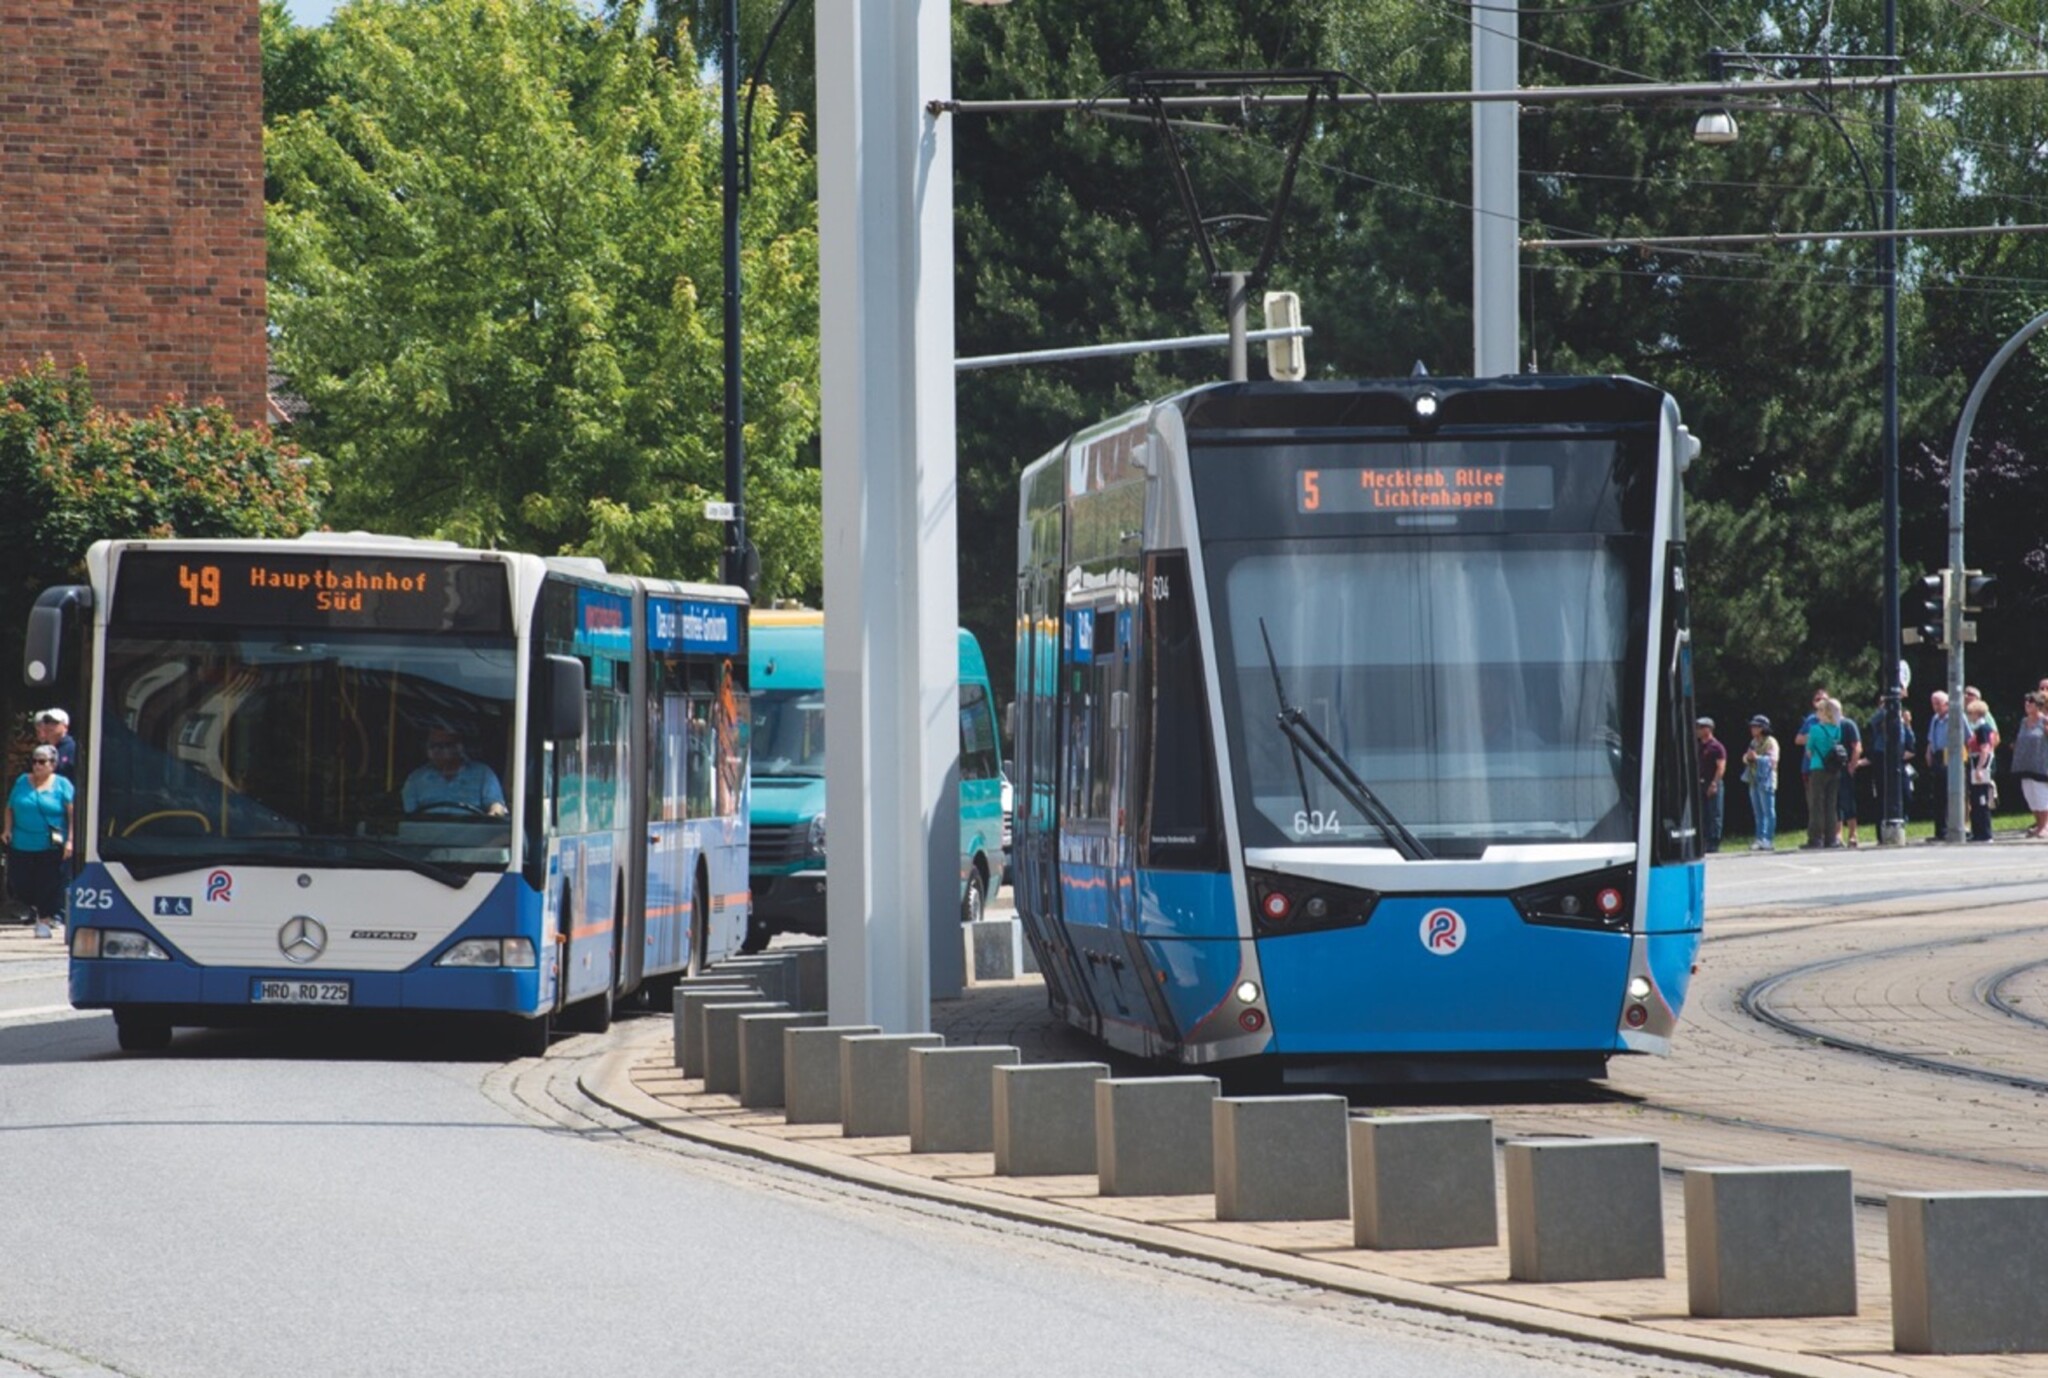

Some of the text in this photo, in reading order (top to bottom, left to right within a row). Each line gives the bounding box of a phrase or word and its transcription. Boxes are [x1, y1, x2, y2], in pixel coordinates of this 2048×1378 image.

[1304, 468, 1505, 510] 5 Mecklenb. Allee
[1374, 489, 1494, 508] Lichtenhagen
[179, 564, 427, 607] 49 Hauptbahnhof
[1152, 575, 1169, 600] 604
[316, 591, 363, 611] Süd
[1294, 810, 1340, 835] 604
[75, 887, 114, 910] 225
[353, 930, 416, 940] CITARO
[262, 983, 348, 1000] HRO RO 225
